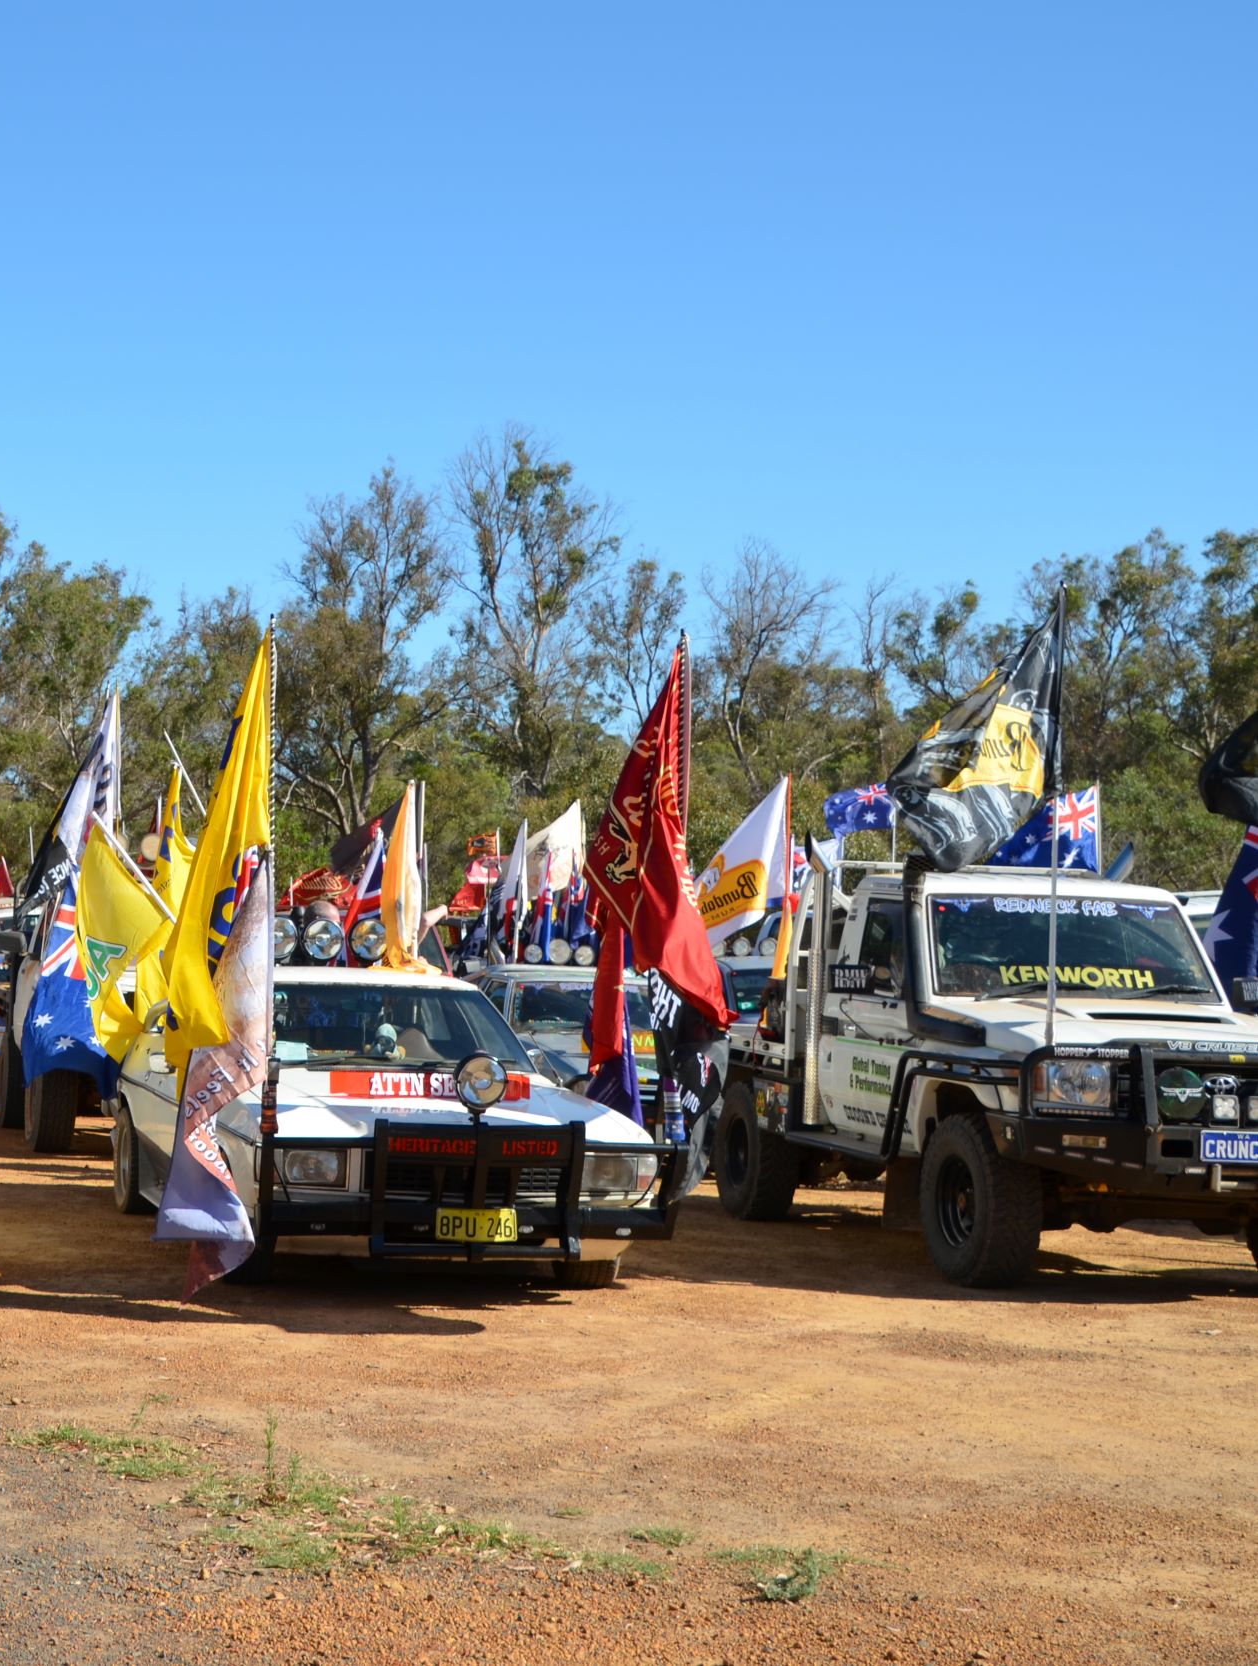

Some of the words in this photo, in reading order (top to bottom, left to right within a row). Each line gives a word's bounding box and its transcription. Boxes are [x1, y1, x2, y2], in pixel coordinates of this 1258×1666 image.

[994, 898, 1079, 914] REDNECK
[1081, 901, 1118, 916] FAB
[1000, 966, 1154, 989] KENWORTH
[370, 1072, 425, 1097] ATTN
[388, 1136, 477, 1155] HERITAGE
[502, 1139, 559, 1157] LISTED
